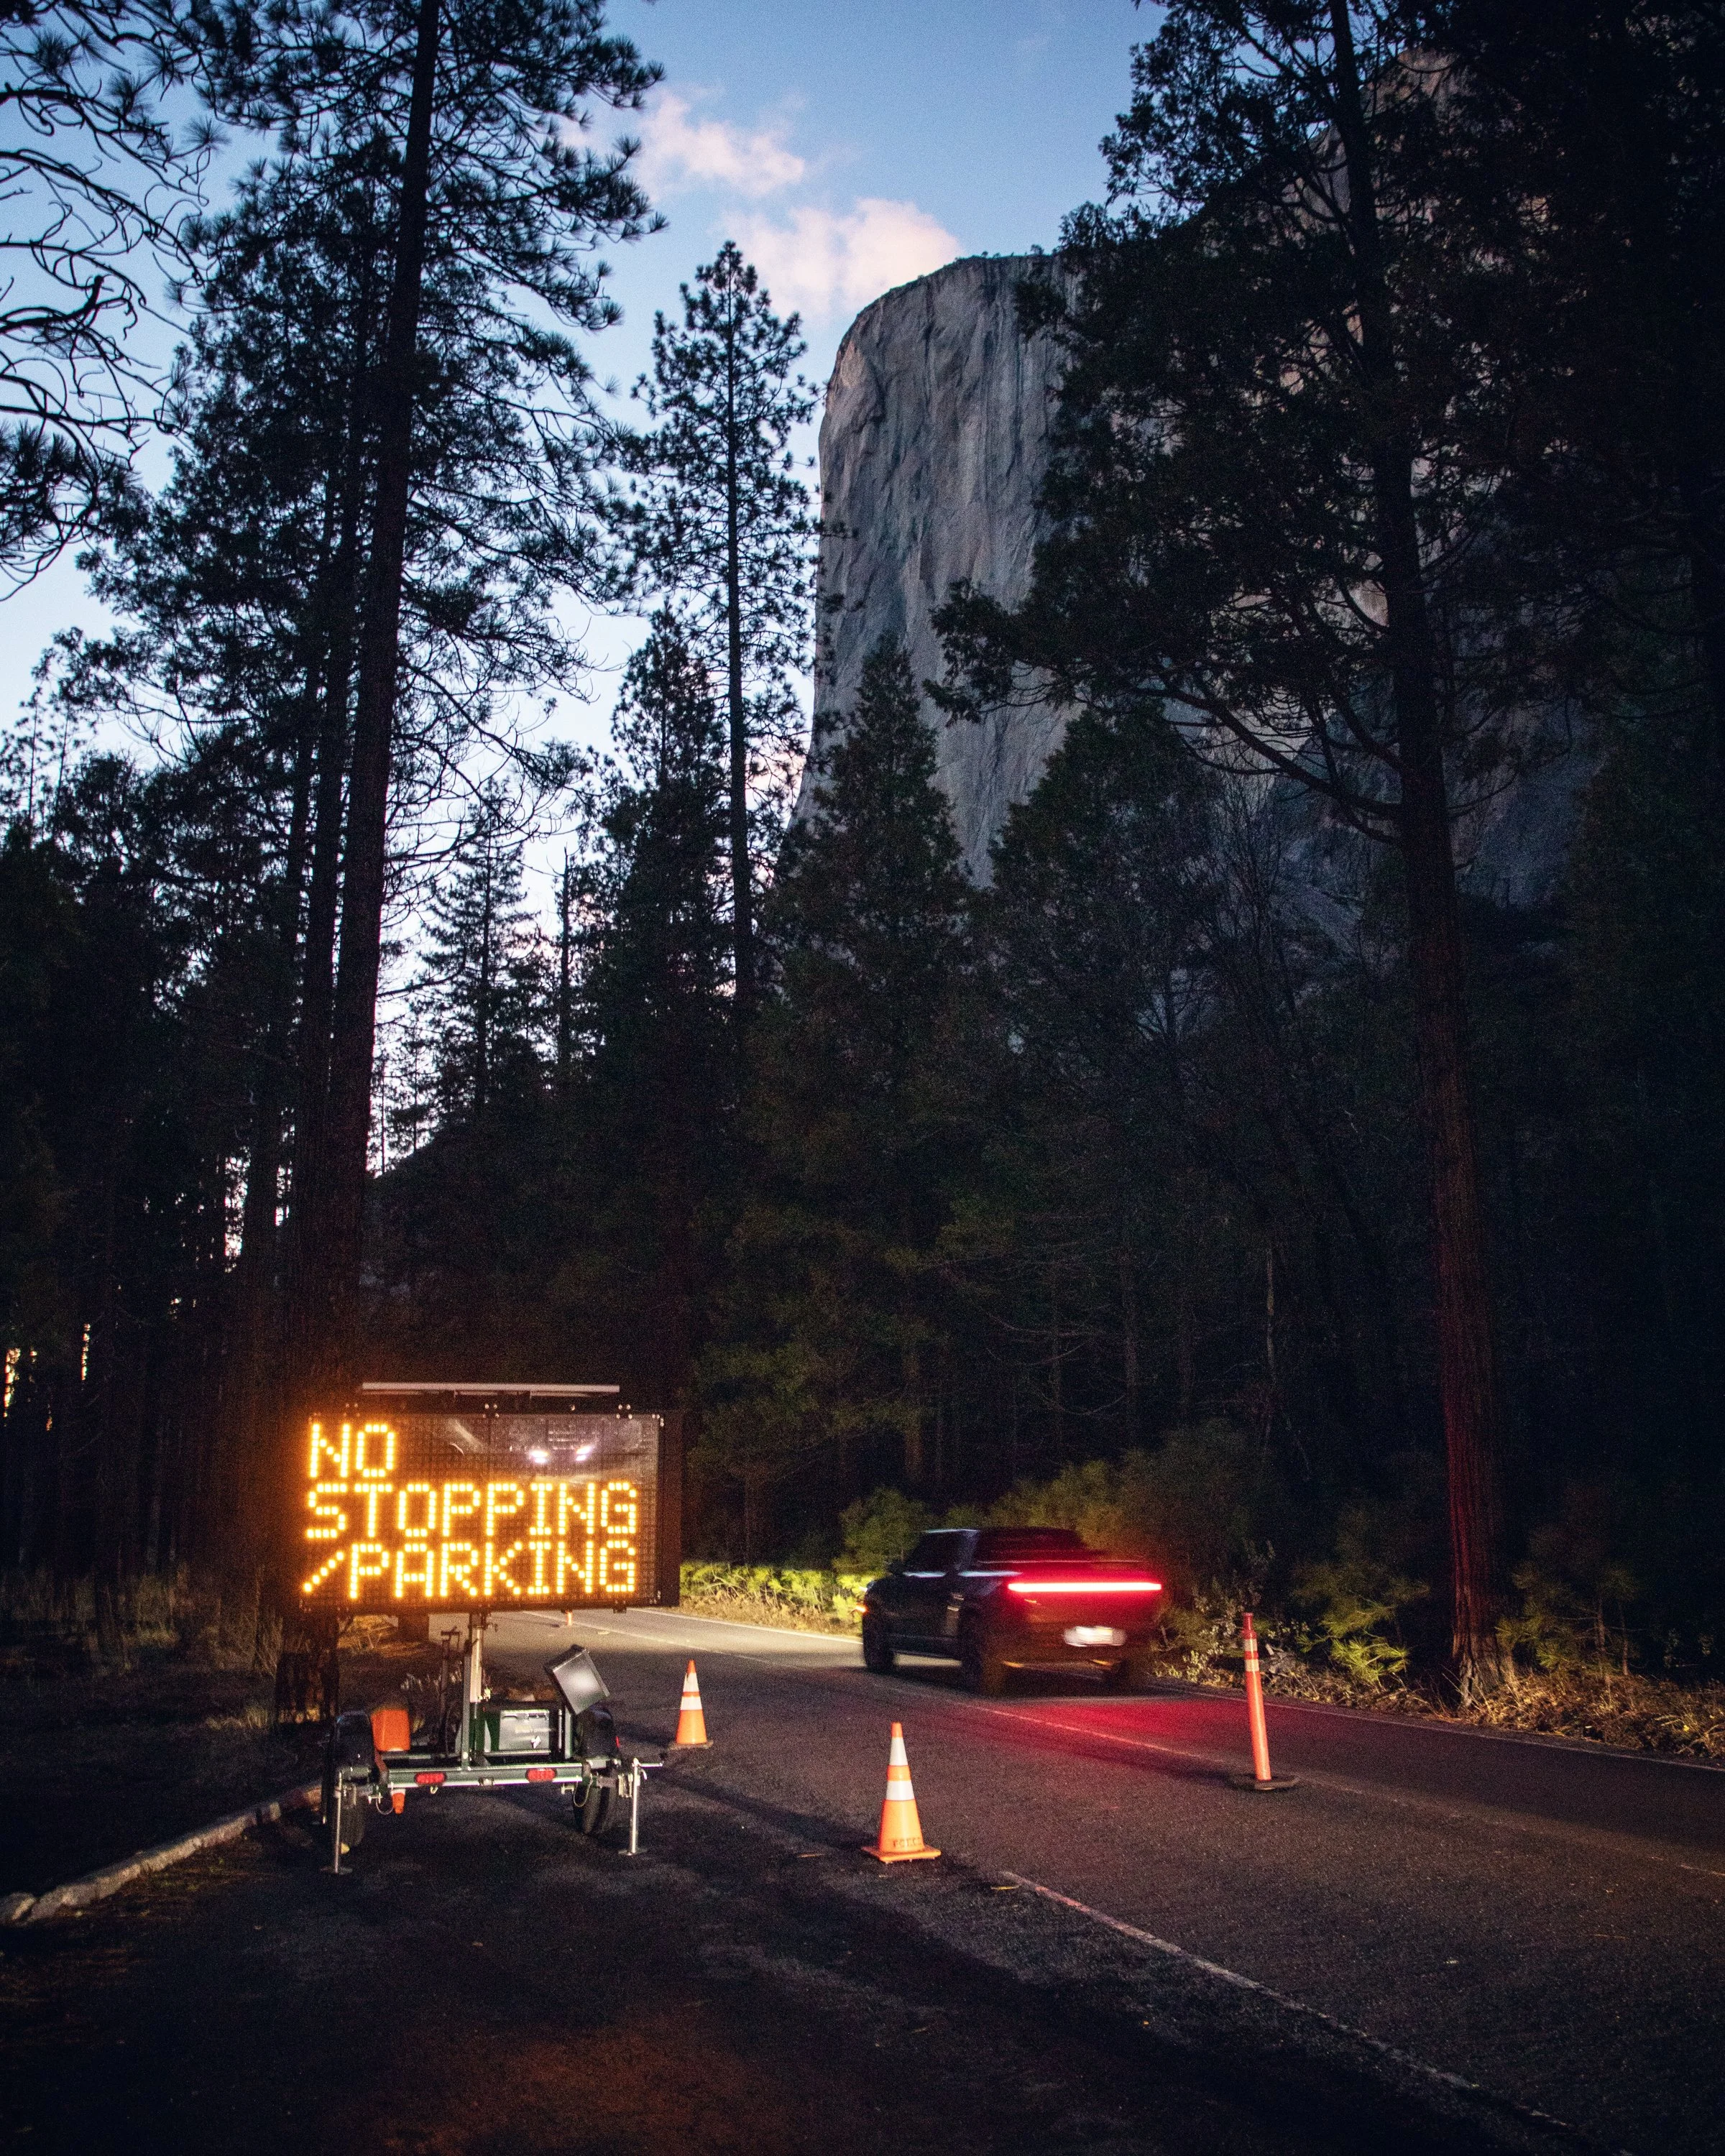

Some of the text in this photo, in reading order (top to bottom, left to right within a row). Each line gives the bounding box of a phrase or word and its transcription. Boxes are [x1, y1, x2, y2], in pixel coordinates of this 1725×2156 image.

[308, 1422, 395, 1478] NO
[305, 1482, 638, 1538] STOPPING
[303, 1539, 636, 1599] /PARKING
